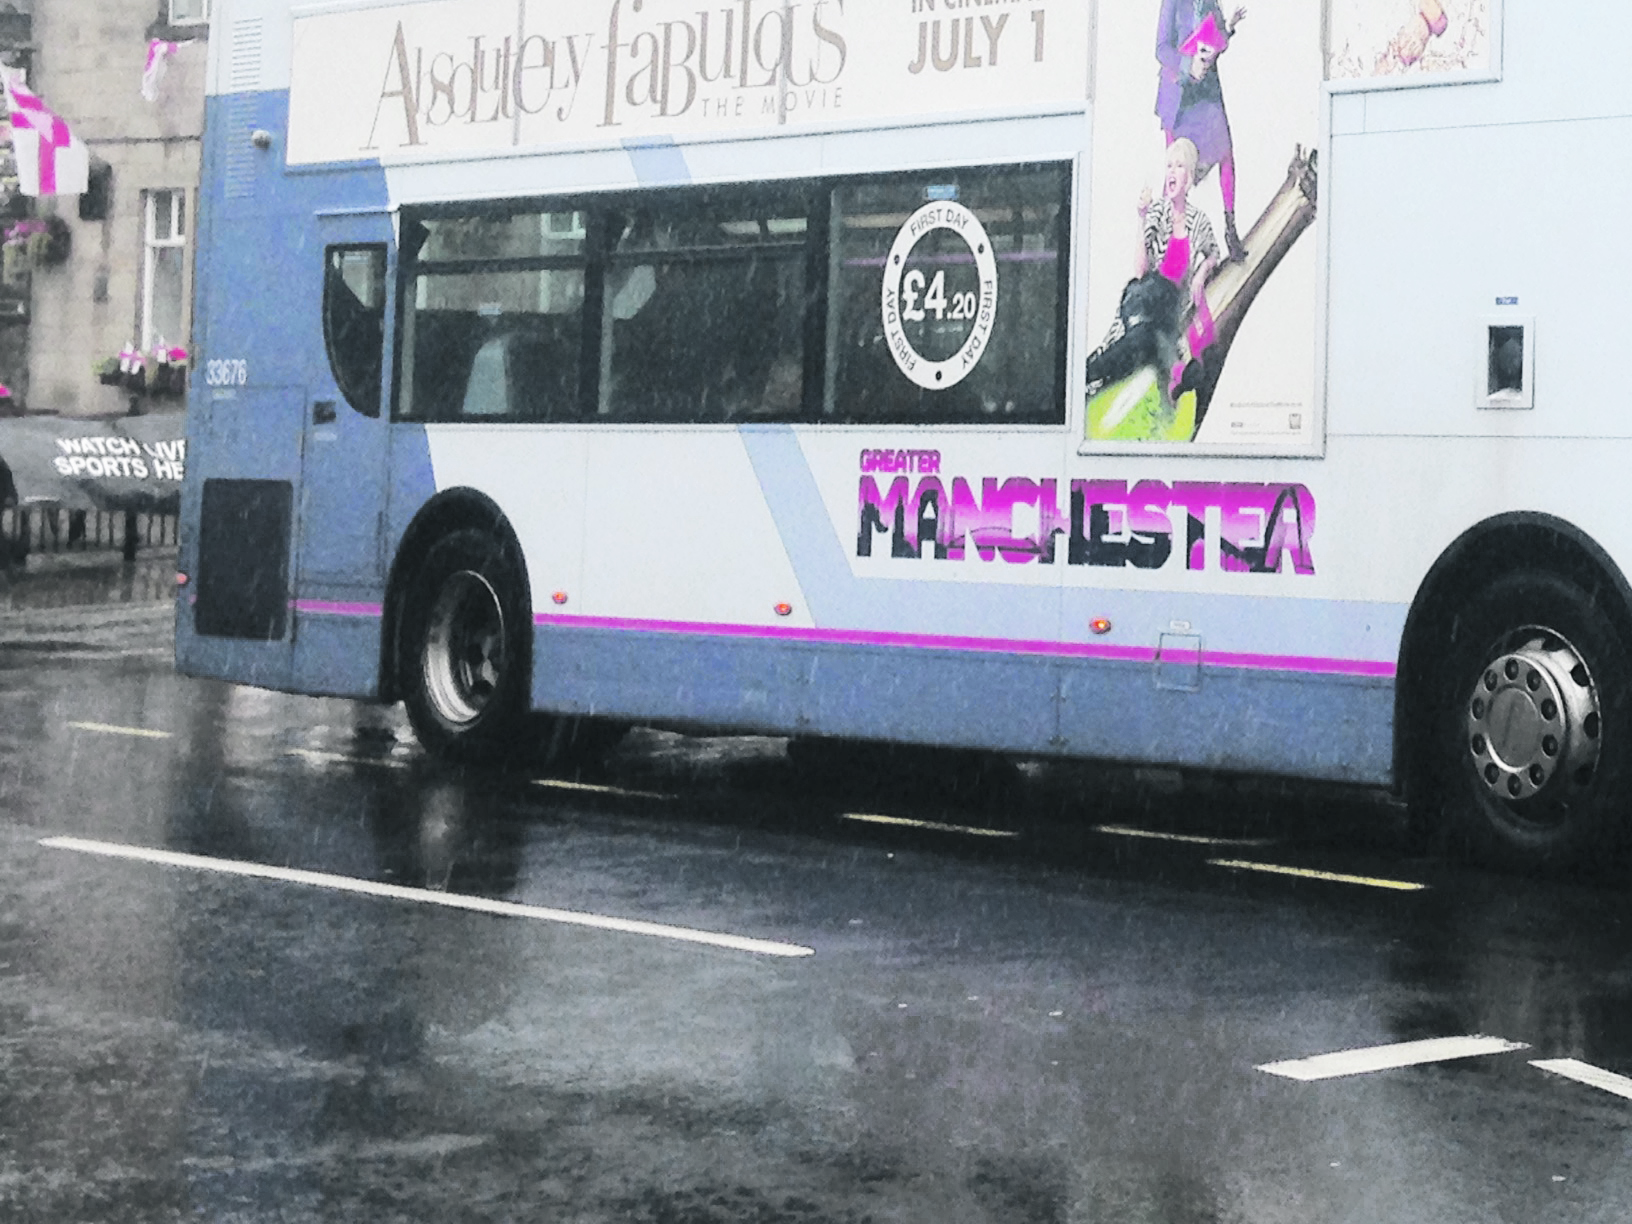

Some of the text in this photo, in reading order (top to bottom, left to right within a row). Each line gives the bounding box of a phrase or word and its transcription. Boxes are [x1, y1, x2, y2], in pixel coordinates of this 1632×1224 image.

[908, 9, 1045, 74] JULY 1
[702, 86, 843, 118] THE MOVIE
[910, 209, 969, 237] FIRST DAY
[901, 269, 976, 322] £4.20
[886, 287, 917, 371] FIRST DAY
[962, 279, 994, 369] FIRST DAY
[206, 358, 247, 386] 33676
[56, 436, 141, 456] WATCH
[859, 448, 941, 474] GREATER
[53, 456, 184, 480] SPORTS HE
[856, 475, 1317, 575] MANCHESTER
